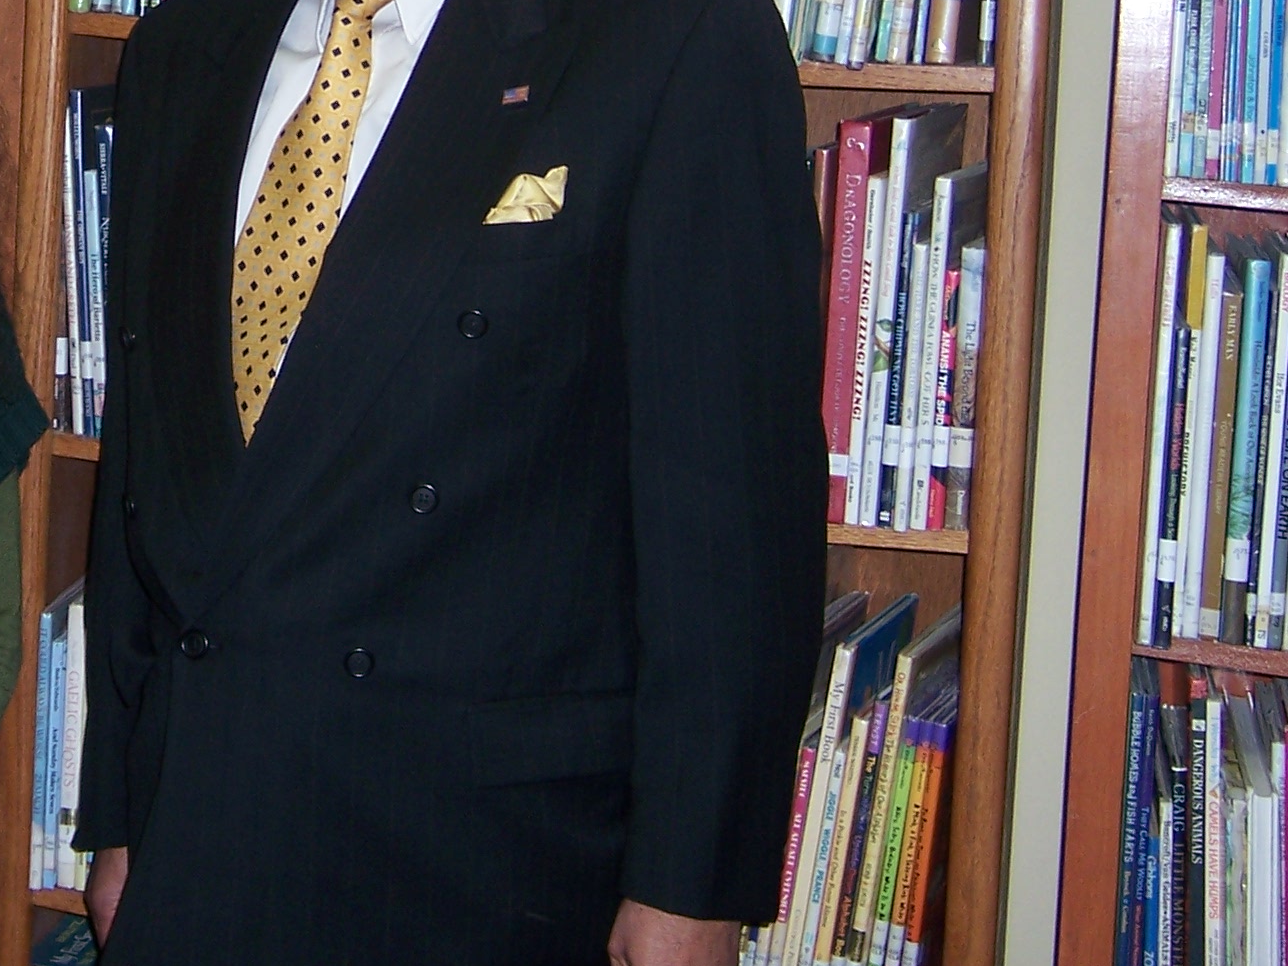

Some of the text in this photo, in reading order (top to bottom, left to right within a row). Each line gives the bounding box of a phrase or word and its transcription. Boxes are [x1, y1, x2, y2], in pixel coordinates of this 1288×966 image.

[838, 173, 862, 304] DRAGONOLOGY
[90, 272, 102, 293] Hero
[91, 254, 101, 269] The
[91, 296, 101, 305] of
[852, 259, 873, 420] ZZZNG! ZZZNG! ZZZNG!
[938, 330, 951, 372] ANANSI
[1225, 305, 1238, 360] EARLY MAN
[937, 375, 948, 397] THE
[63, 671, 80, 788] GAELIC GHOSTS
[820, 682, 845, 763] My First Book
[1131, 711, 1143, 747] BUBBLE
[1128, 749, 1140, 782] HOMES
[1125, 801, 1138, 825] FISH
[1191, 739, 1204, 864] DANGEROUS ANIMALS
[811, 792, 837, 904] JIGGLE WIGGLE PRANCE
[1123, 828, 1136, 862] FARTS
[1208, 801, 1220, 920] CAMELS HAVE HUMPS
[1146, 855, 1156, 899] Gibbons
[1172, 783, 1185, 966] CRAIG LITTLE MONSTE
